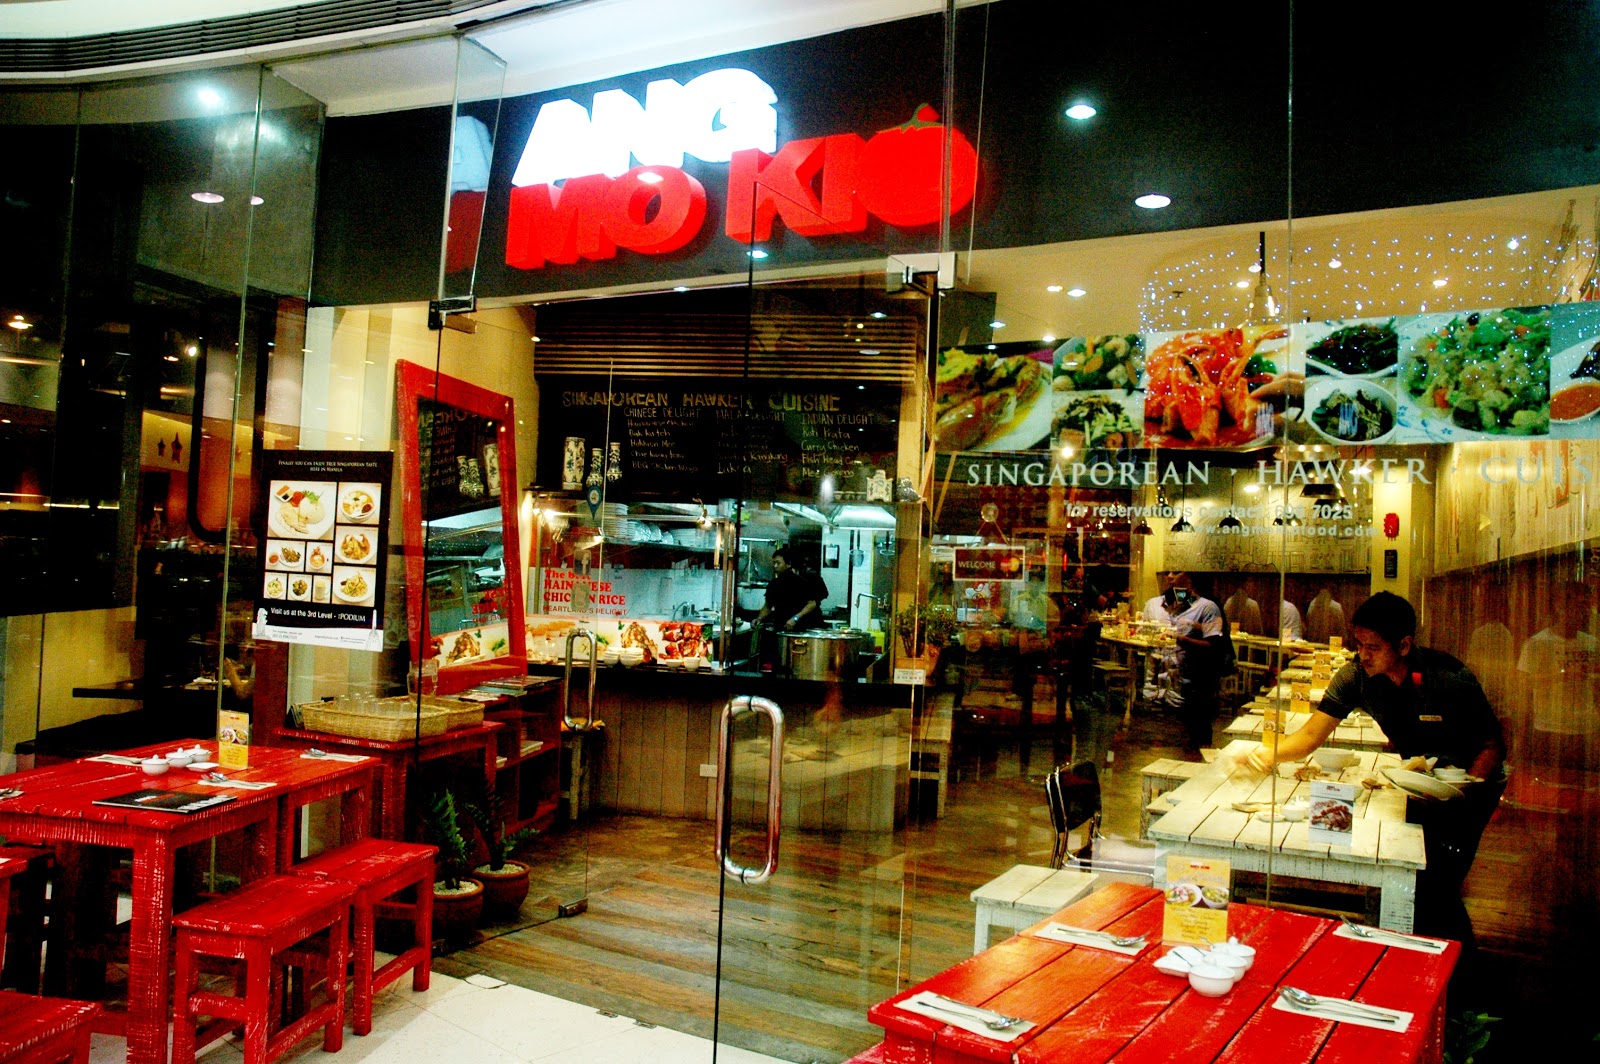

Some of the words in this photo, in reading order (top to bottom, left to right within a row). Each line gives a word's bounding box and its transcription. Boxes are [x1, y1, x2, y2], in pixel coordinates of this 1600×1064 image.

[511, 67, 778, 187] ANG
[505, 164, 707, 269] MO
[725, 103, 978, 243] KIO
[768, 392, 841, 412] CUISINE
[624, 407, 658, 418] CHINESE
[801, 413, 834, 425] INDIAN
[837, 413, 875, 425] DELIGHT
[801, 440, 826, 454] Curry
[968, 460, 1211, 487] SINGAPOREAN
[1256, 458, 1432, 486] HAWKER
[1482, 455, 1593, 485] CUIS
[1065, 502, 1089, 517] for
[1093, 504, 1192, 518] reservations
[1312, 504, 1354, 520] 7025
[958, 560, 996, 570] WELCOME
[544, 569, 565, 579] The
[544, 579, 612, 592] HAINESE
[543, 591, 596, 604] CHICN
[599, 594, 626, 605] RICE
[307, 610, 317, 618] 3rd
[318, 611, 333, 619] Level
[543, 605, 594, 614] HEARTLANDS
[596, 607, 627, 616] DELIGHT
